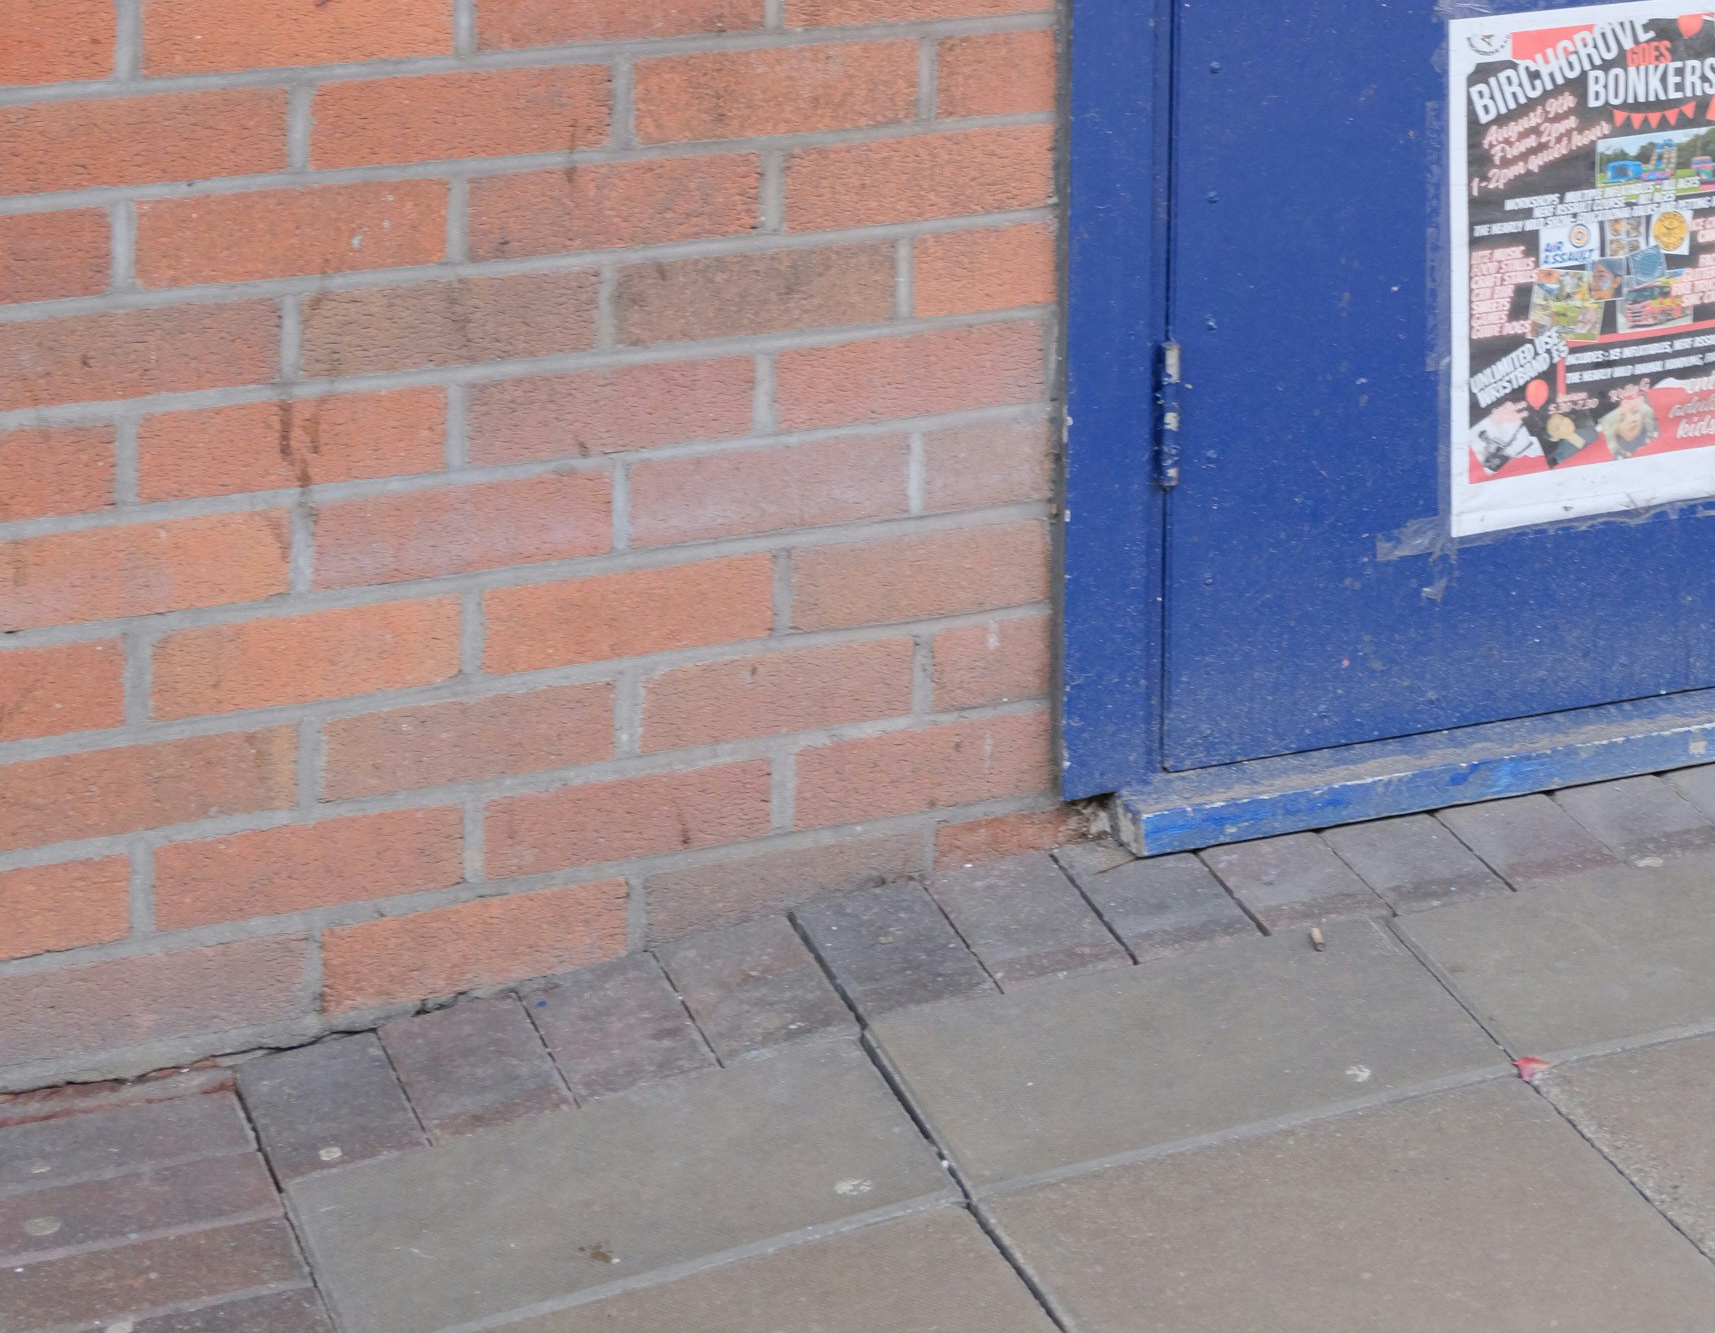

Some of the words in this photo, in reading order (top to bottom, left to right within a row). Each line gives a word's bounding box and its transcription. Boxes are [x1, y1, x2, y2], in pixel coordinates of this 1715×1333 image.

[1468, 20, 1657, 125] BIRCHGROVE
[1625, 39, 1673, 68] GOES
[1483, 104, 1546, 149] August
[1545, 91, 1578, 118] 9th
[1490, 129, 1537, 166] From
[1540, 116, 1580, 148] 2pm
[1470, 159, 1527, 197] 1-2pm
[1527, 137, 1572, 173] quiet
[1468, 342, 1536, 394] UNLIMITED
[1534, 331, 1559, 358] USE
[1476, 352, 1551, 408] WRISTBAND
